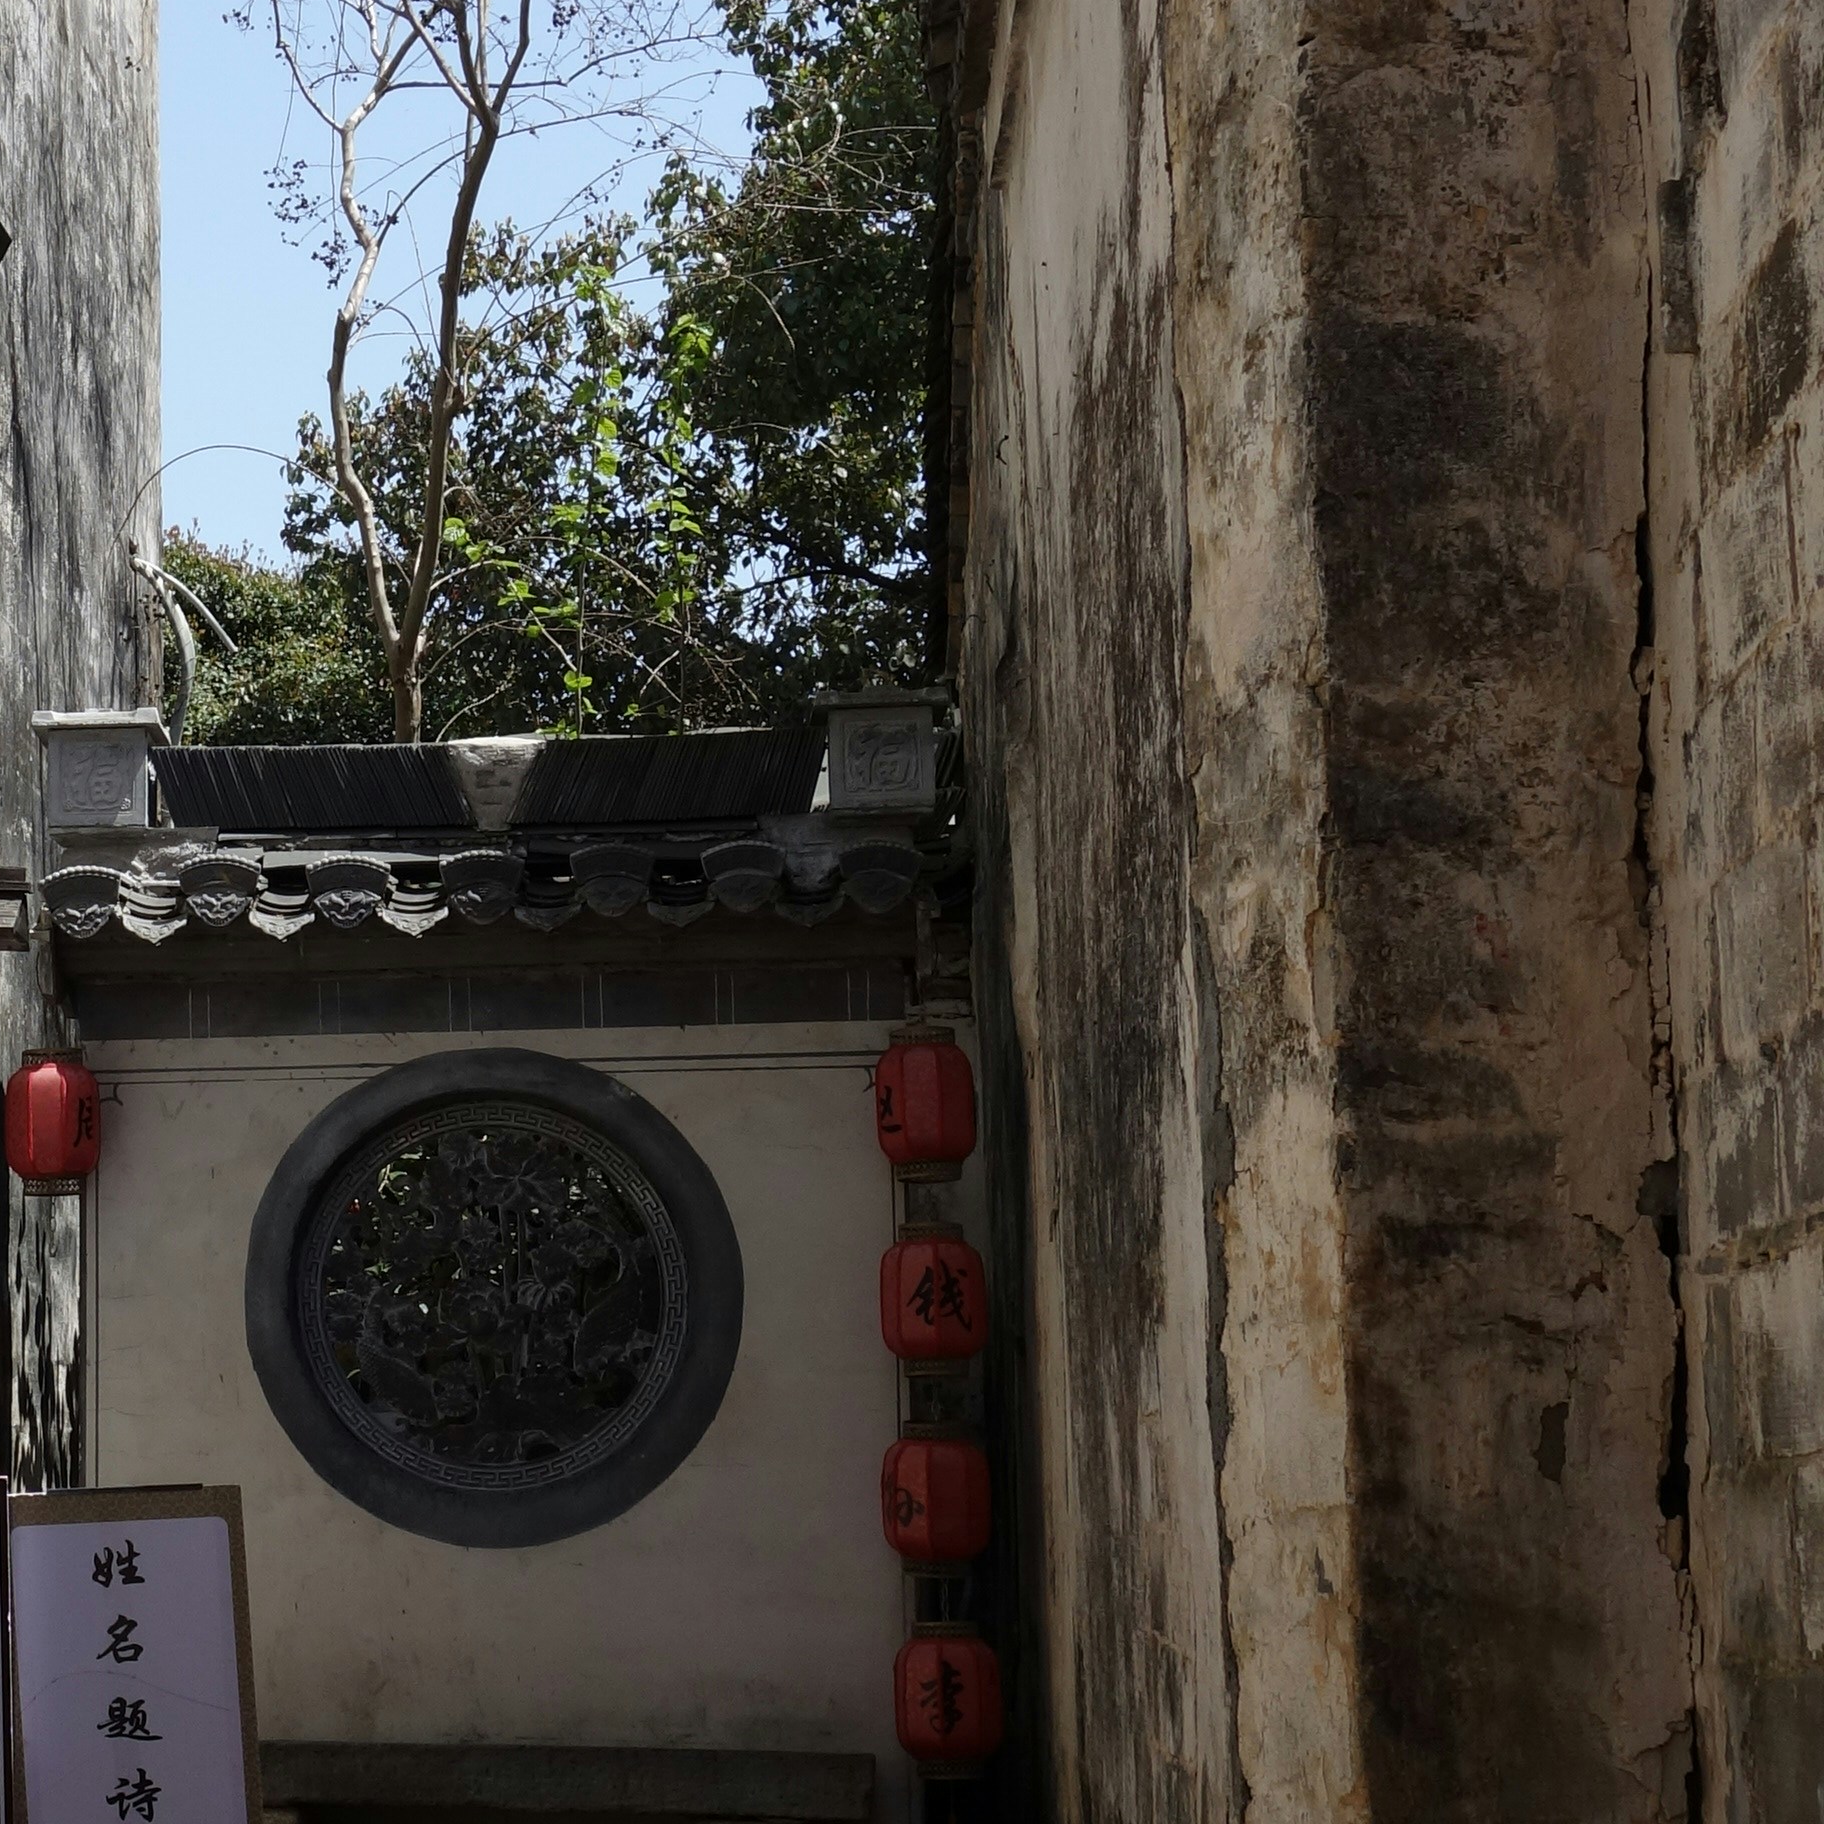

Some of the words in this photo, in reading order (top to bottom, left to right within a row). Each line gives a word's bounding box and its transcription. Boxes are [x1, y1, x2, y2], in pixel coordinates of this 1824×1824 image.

[905, 1259, 974, 1334] 钱
[92, 1539, 164, 1823] 姓名题诗
[920, 1660, 964, 1735] 李
